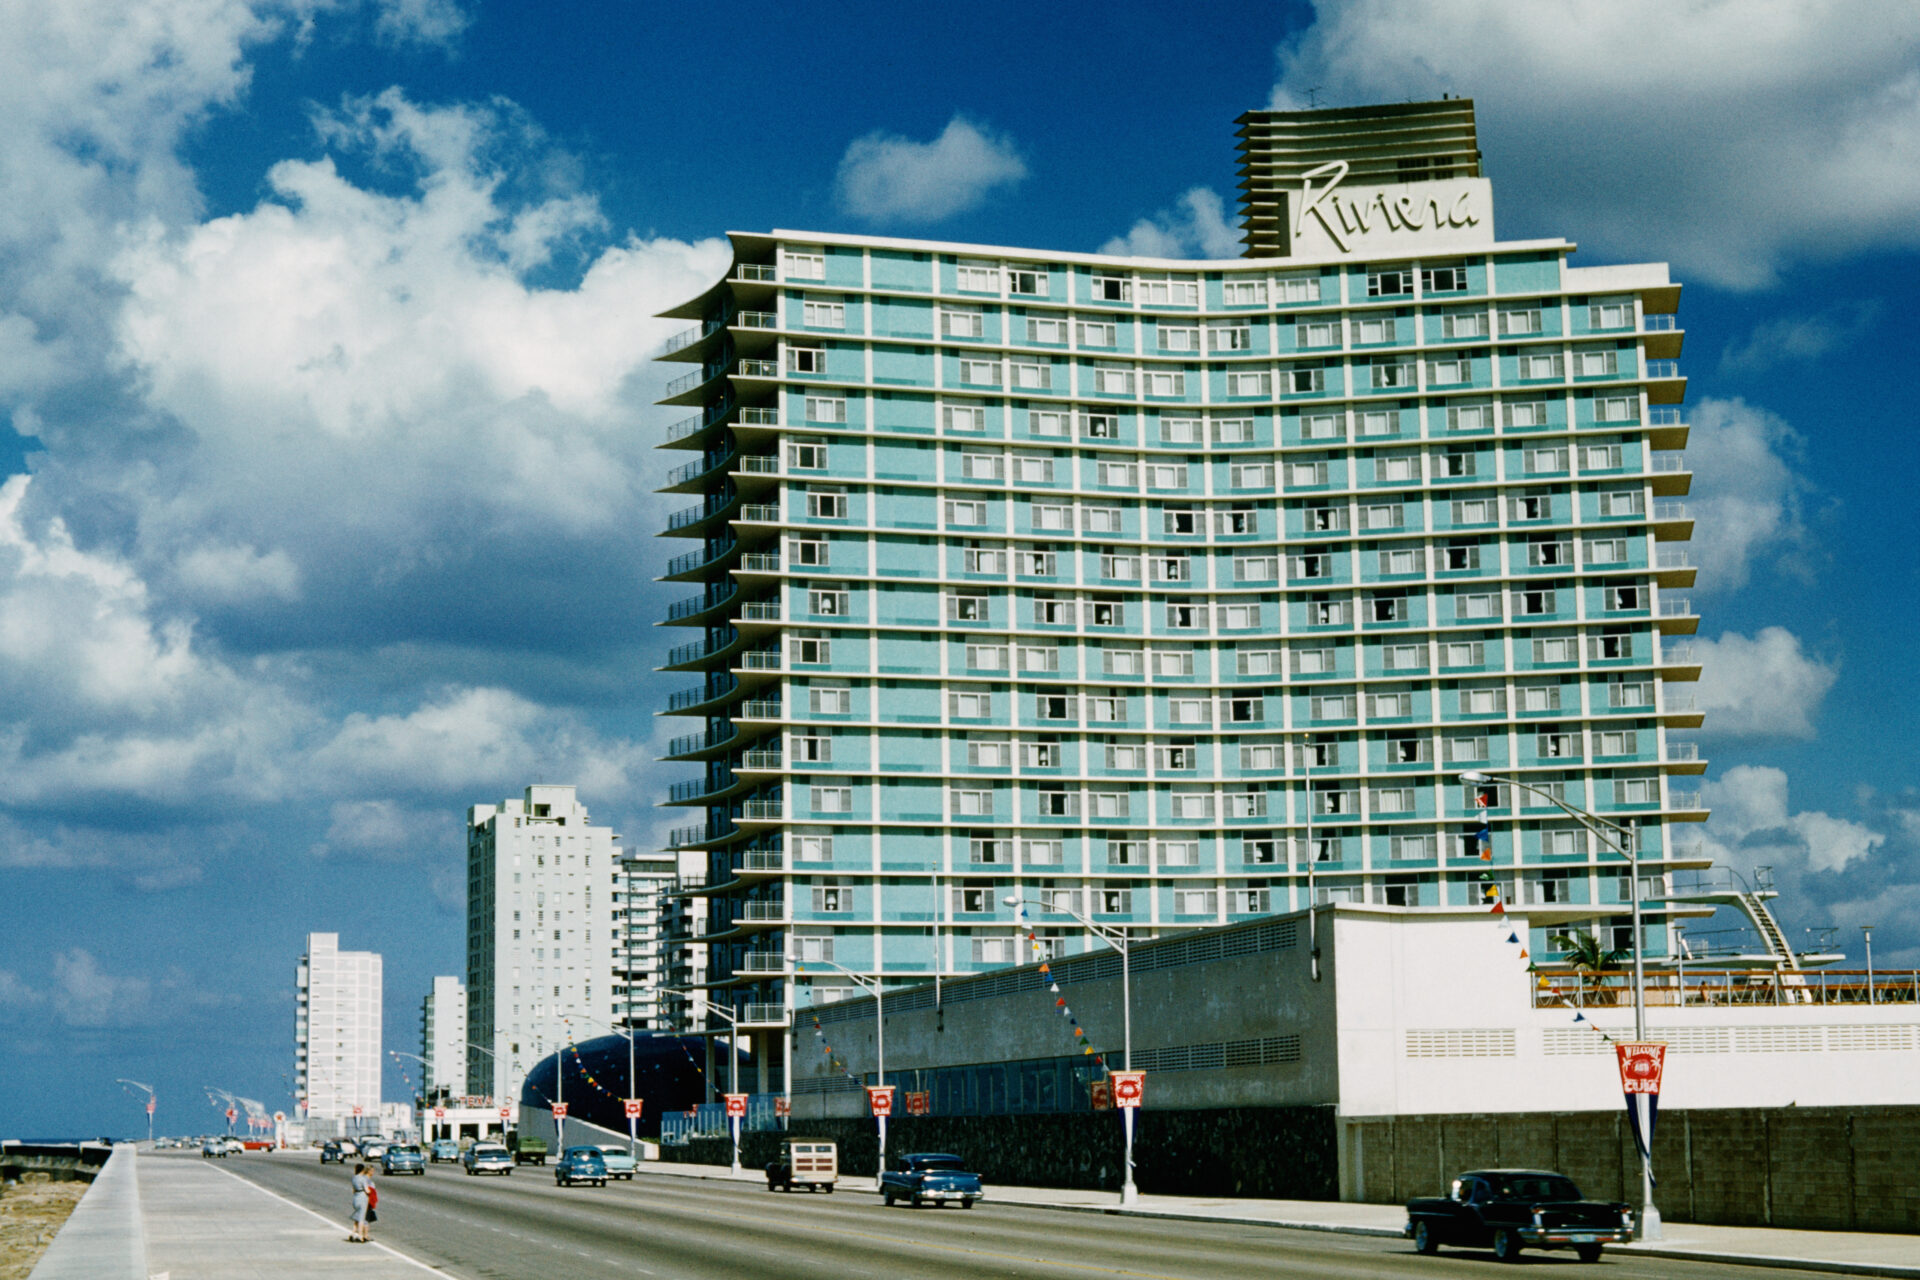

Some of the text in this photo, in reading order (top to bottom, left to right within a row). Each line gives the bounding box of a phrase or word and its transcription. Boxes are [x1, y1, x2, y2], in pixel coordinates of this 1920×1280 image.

[1295, 160, 1479, 253] Riviera
[1624, 1046, 1661, 1059] WELCOME
[1624, 1079, 1659, 1093] CUBA
[459, 1096, 513, 1106] TEXAO
